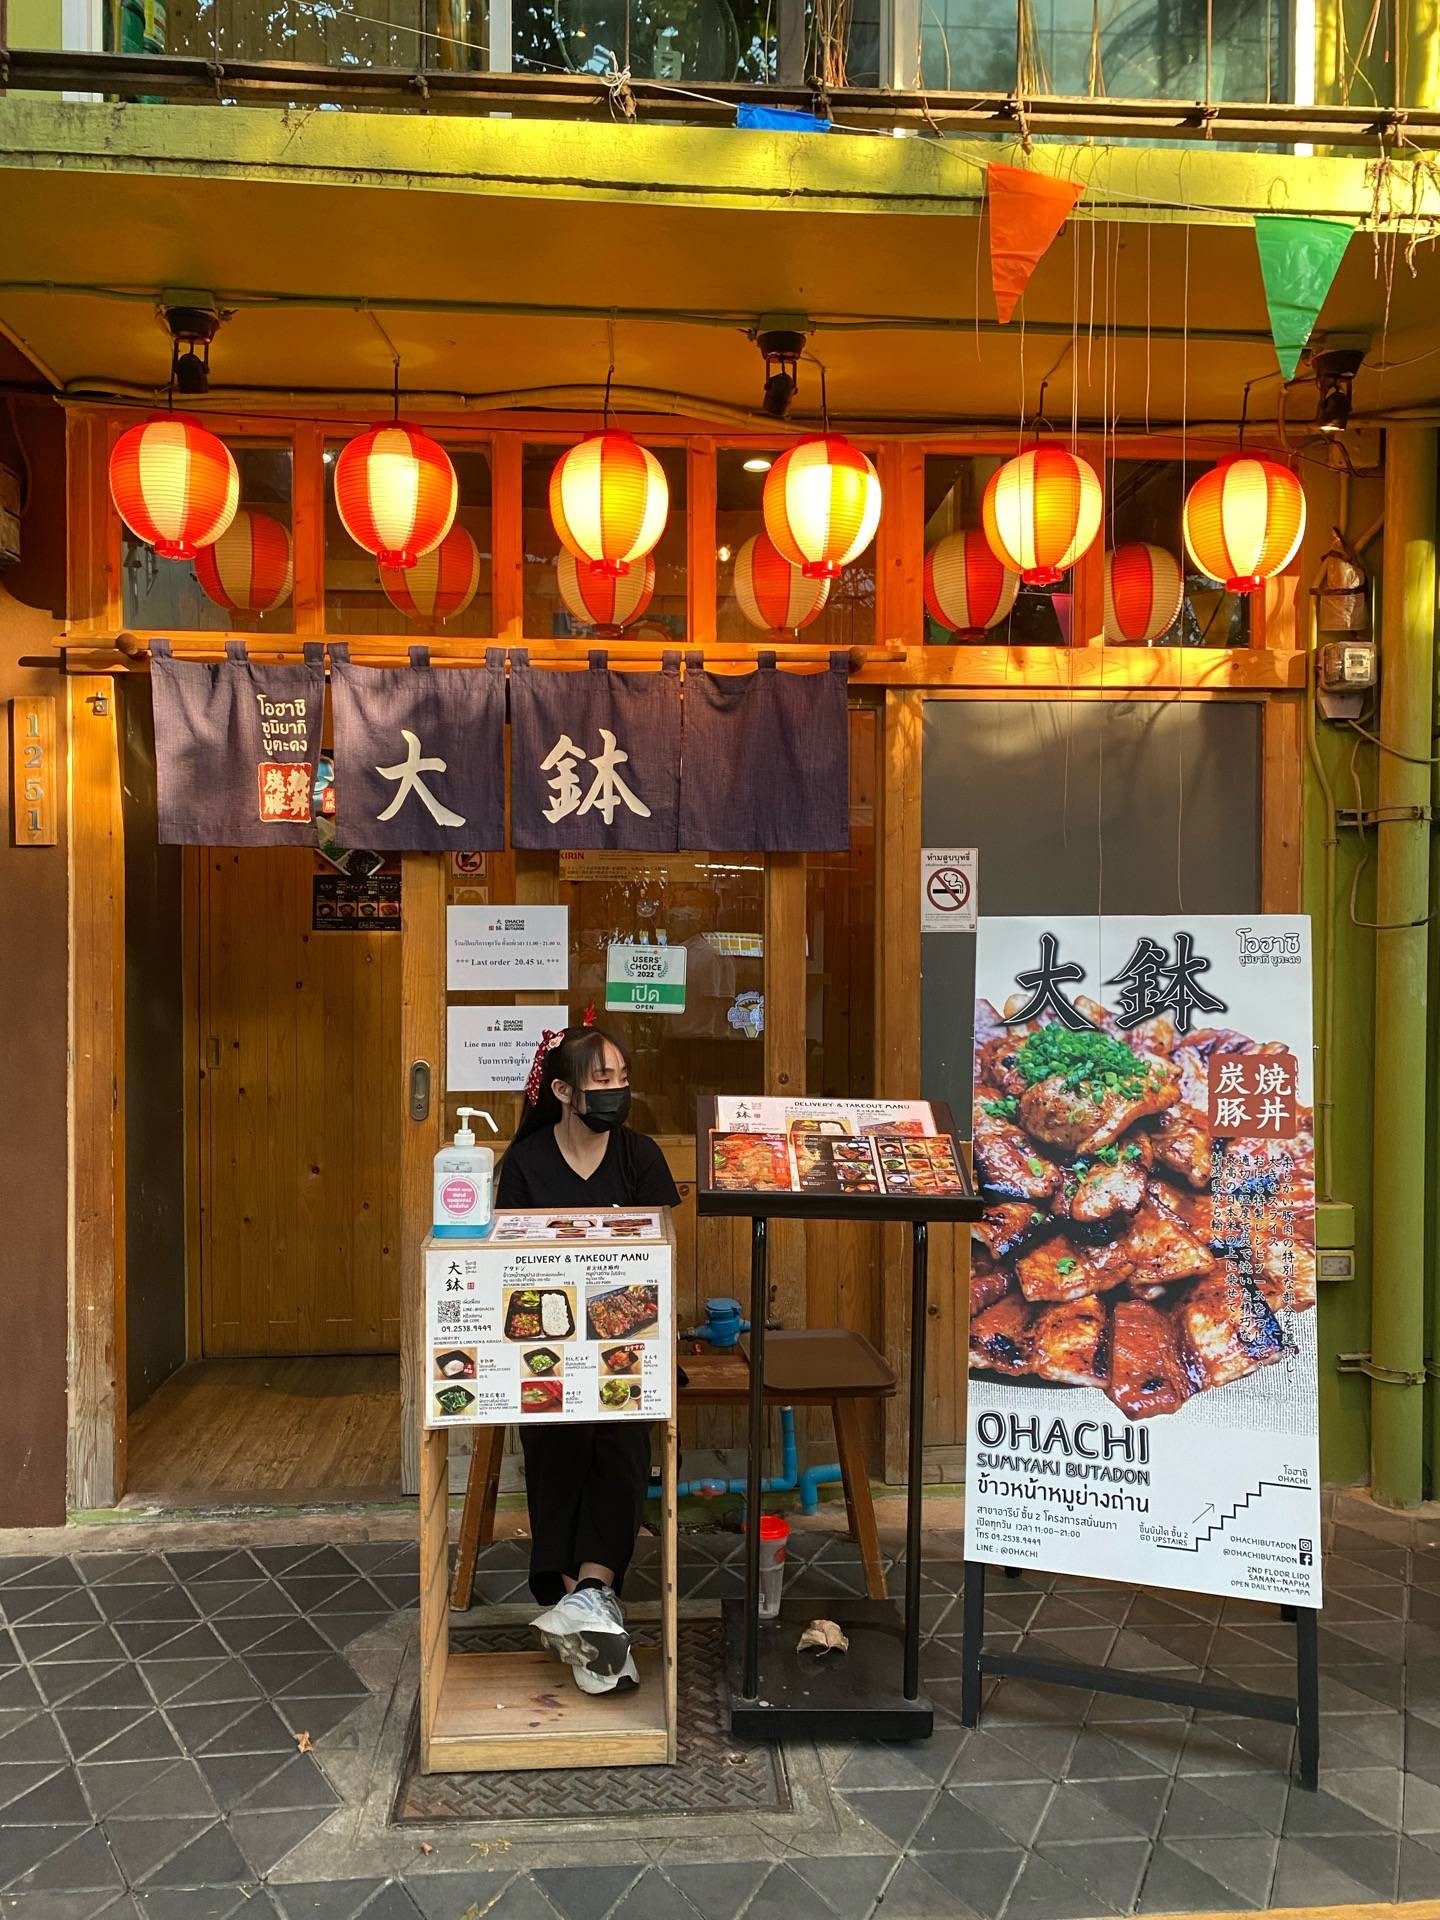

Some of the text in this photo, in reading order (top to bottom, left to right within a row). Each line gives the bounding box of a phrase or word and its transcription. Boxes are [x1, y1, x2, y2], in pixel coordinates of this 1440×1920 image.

[256, 694, 306, 717] โอฮาชิ
[23, 712, 43, 832] 1251
[375, 728, 652, 828] 大 鉢
[1235, 928, 1301, 954] โอฮาชิ
[471, 958, 488, 966] Last
[489, 958, 511, 966] order
[514, 958, 535, 966] 20.45
[629, 963, 662, 971] CHOICE
[631, 984, 660, 1002] เปิด
[1210, 1152, 1224, 1245] 新潟県から輸入
[1267, 1154, 1280, 1247] 大きなスライス
[515, 1253, 650, 1264] DELIVERY & TAKEOUT MANU
[441, 1324, 492, 1333] 09.2538.9449
[976, 1410, 1149, 1464] OHACHI
[977, 1453, 1150, 1487] SUMIYAKI BUTADON
[1277, 1475, 1309, 1485] OHACHI
[977, 1472, 1149, 1513] ข้าวหน้าหมูย่างถ่าน
[976, 1518, 1012, 1531] เปิดทุกวัน
[1015, 1523, 1033, 1533] เวลา
[975, 1527, 989, 1540] โทร
[1183, 1531, 1189, 1539] 2
[1152, 1536, 1188, 1547] UPSTAIRS
[1230, 1535, 1297, 1550] OHACHIBUTADON
[976, 1543, 994, 1553] LINE
[1000, 1546, 1038, 1558] @OHACHI
[1222, 1549, 1298, 1564] @OHACHIBUTADON
[1247, 1566, 1310, 1580] 2ND FLOOR LIDO
[1230, 1580, 1250, 1588] OPEN
[1251, 1582, 1272, 1592] DAILY
